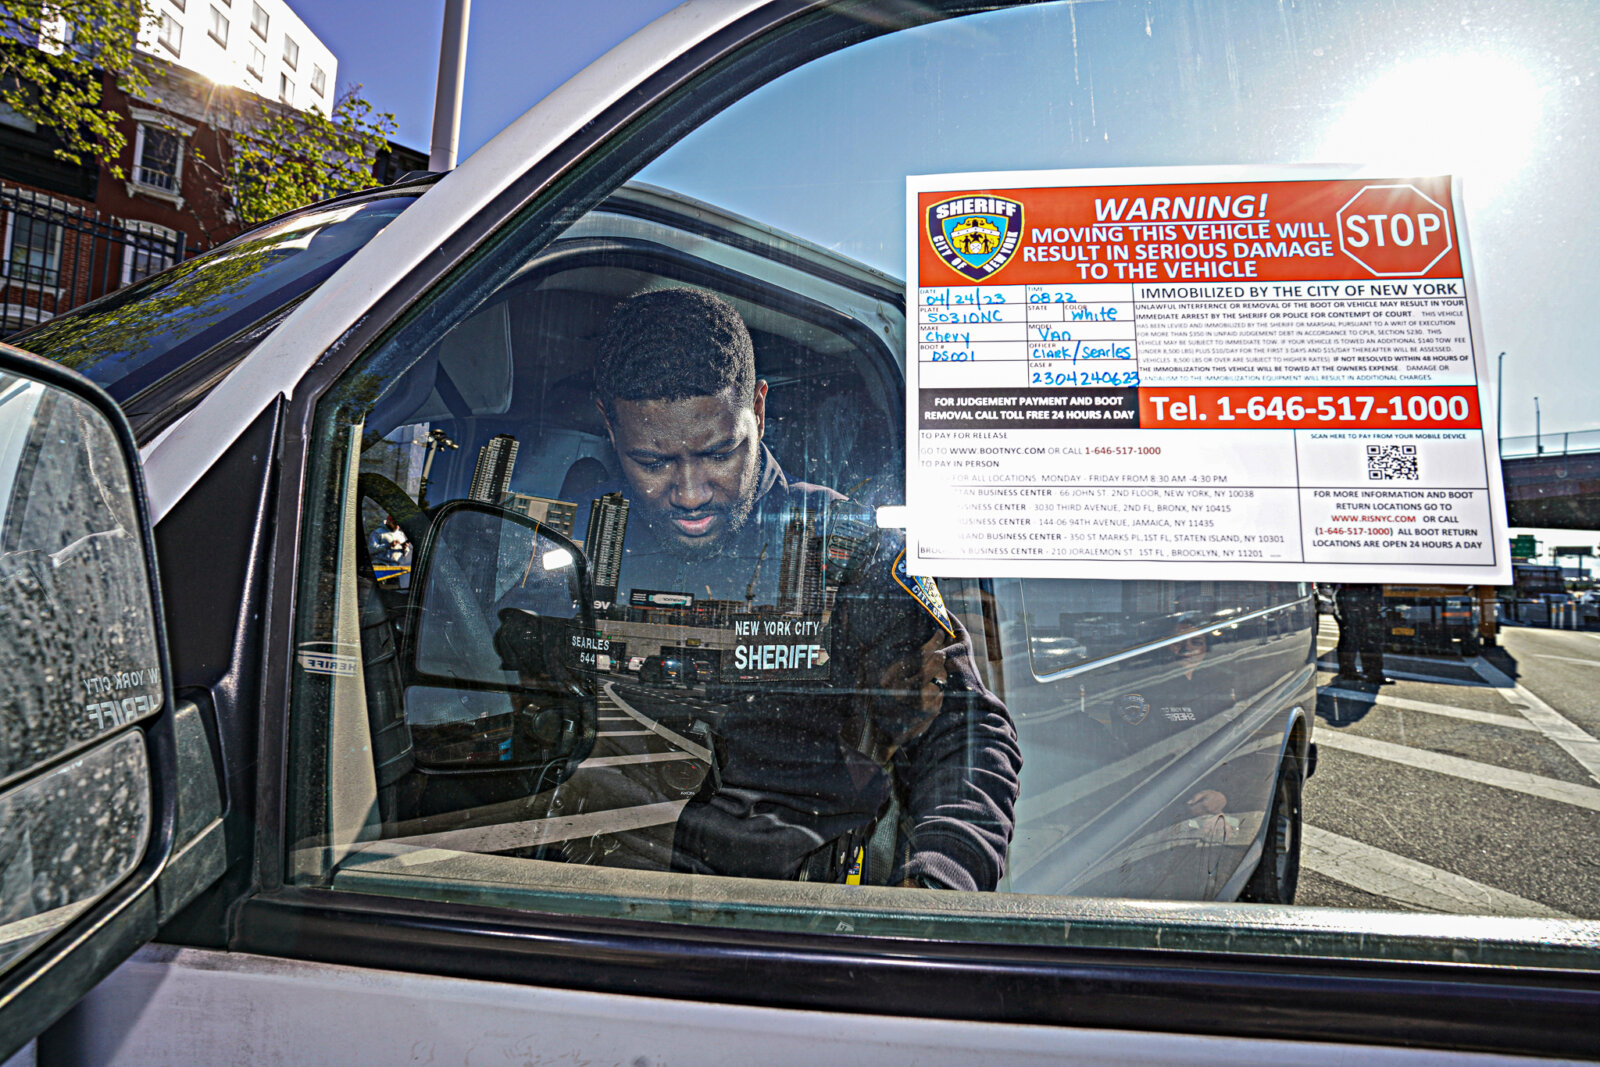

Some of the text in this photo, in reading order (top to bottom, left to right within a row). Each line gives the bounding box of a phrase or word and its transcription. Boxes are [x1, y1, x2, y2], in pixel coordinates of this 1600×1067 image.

[936, 198, 1016, 219] SHERIFF
[1095, 193, 1268, 222] WARNING!
[1032, 222, 1330, 243] MOVING THIS VEHICLE WILL
[1346, 213, 1441, 247] STOP
[933, 235, 967, 269] CITY OF
[983, 231, 1018, 273] NEW YORK
[1023, 240, 1334, 262] RESULT IN SERIOUS DAMAGE
[1076, 260, 1257, 280] TO THE VEHICLE
[927, 288, 1006, 310] 04/24/23
[1142, 283, 1458, 299] IMMOBILIZED BY THE CITY OF NEW YORK
[1032, 371, 1140, 388] 2304240623
[935, 397, 1123, 406] FOR JUDGEMENT PAYMENT AND BOOT
[1149, 395, 1469, 421] Tel. 1-646-517-1000
[925, 412, 973, 420] REMOVAL
[1026, 411, 1050, 419] FREE
[1052, 411, 1064, 419] 24
[1066, 411, 1101, 419] HOURS
[1104, 411, 1111, 419] A
[1114, 411, 1135, 419] DAY
[1085, 446, 1161, 455] 1-646-517-1000
[1331, 515, 1416, 523] WWW.RISNYC.COM
[1315, 527, 1393, 536] (1-646-517-1000)
[735, 621, 819, 635] NEW YORK CITY
[572, 635, 609, 650] SEARLES
[580, 653, 595, 665] 544
[735, 645, 821, 670] SHERIFF
